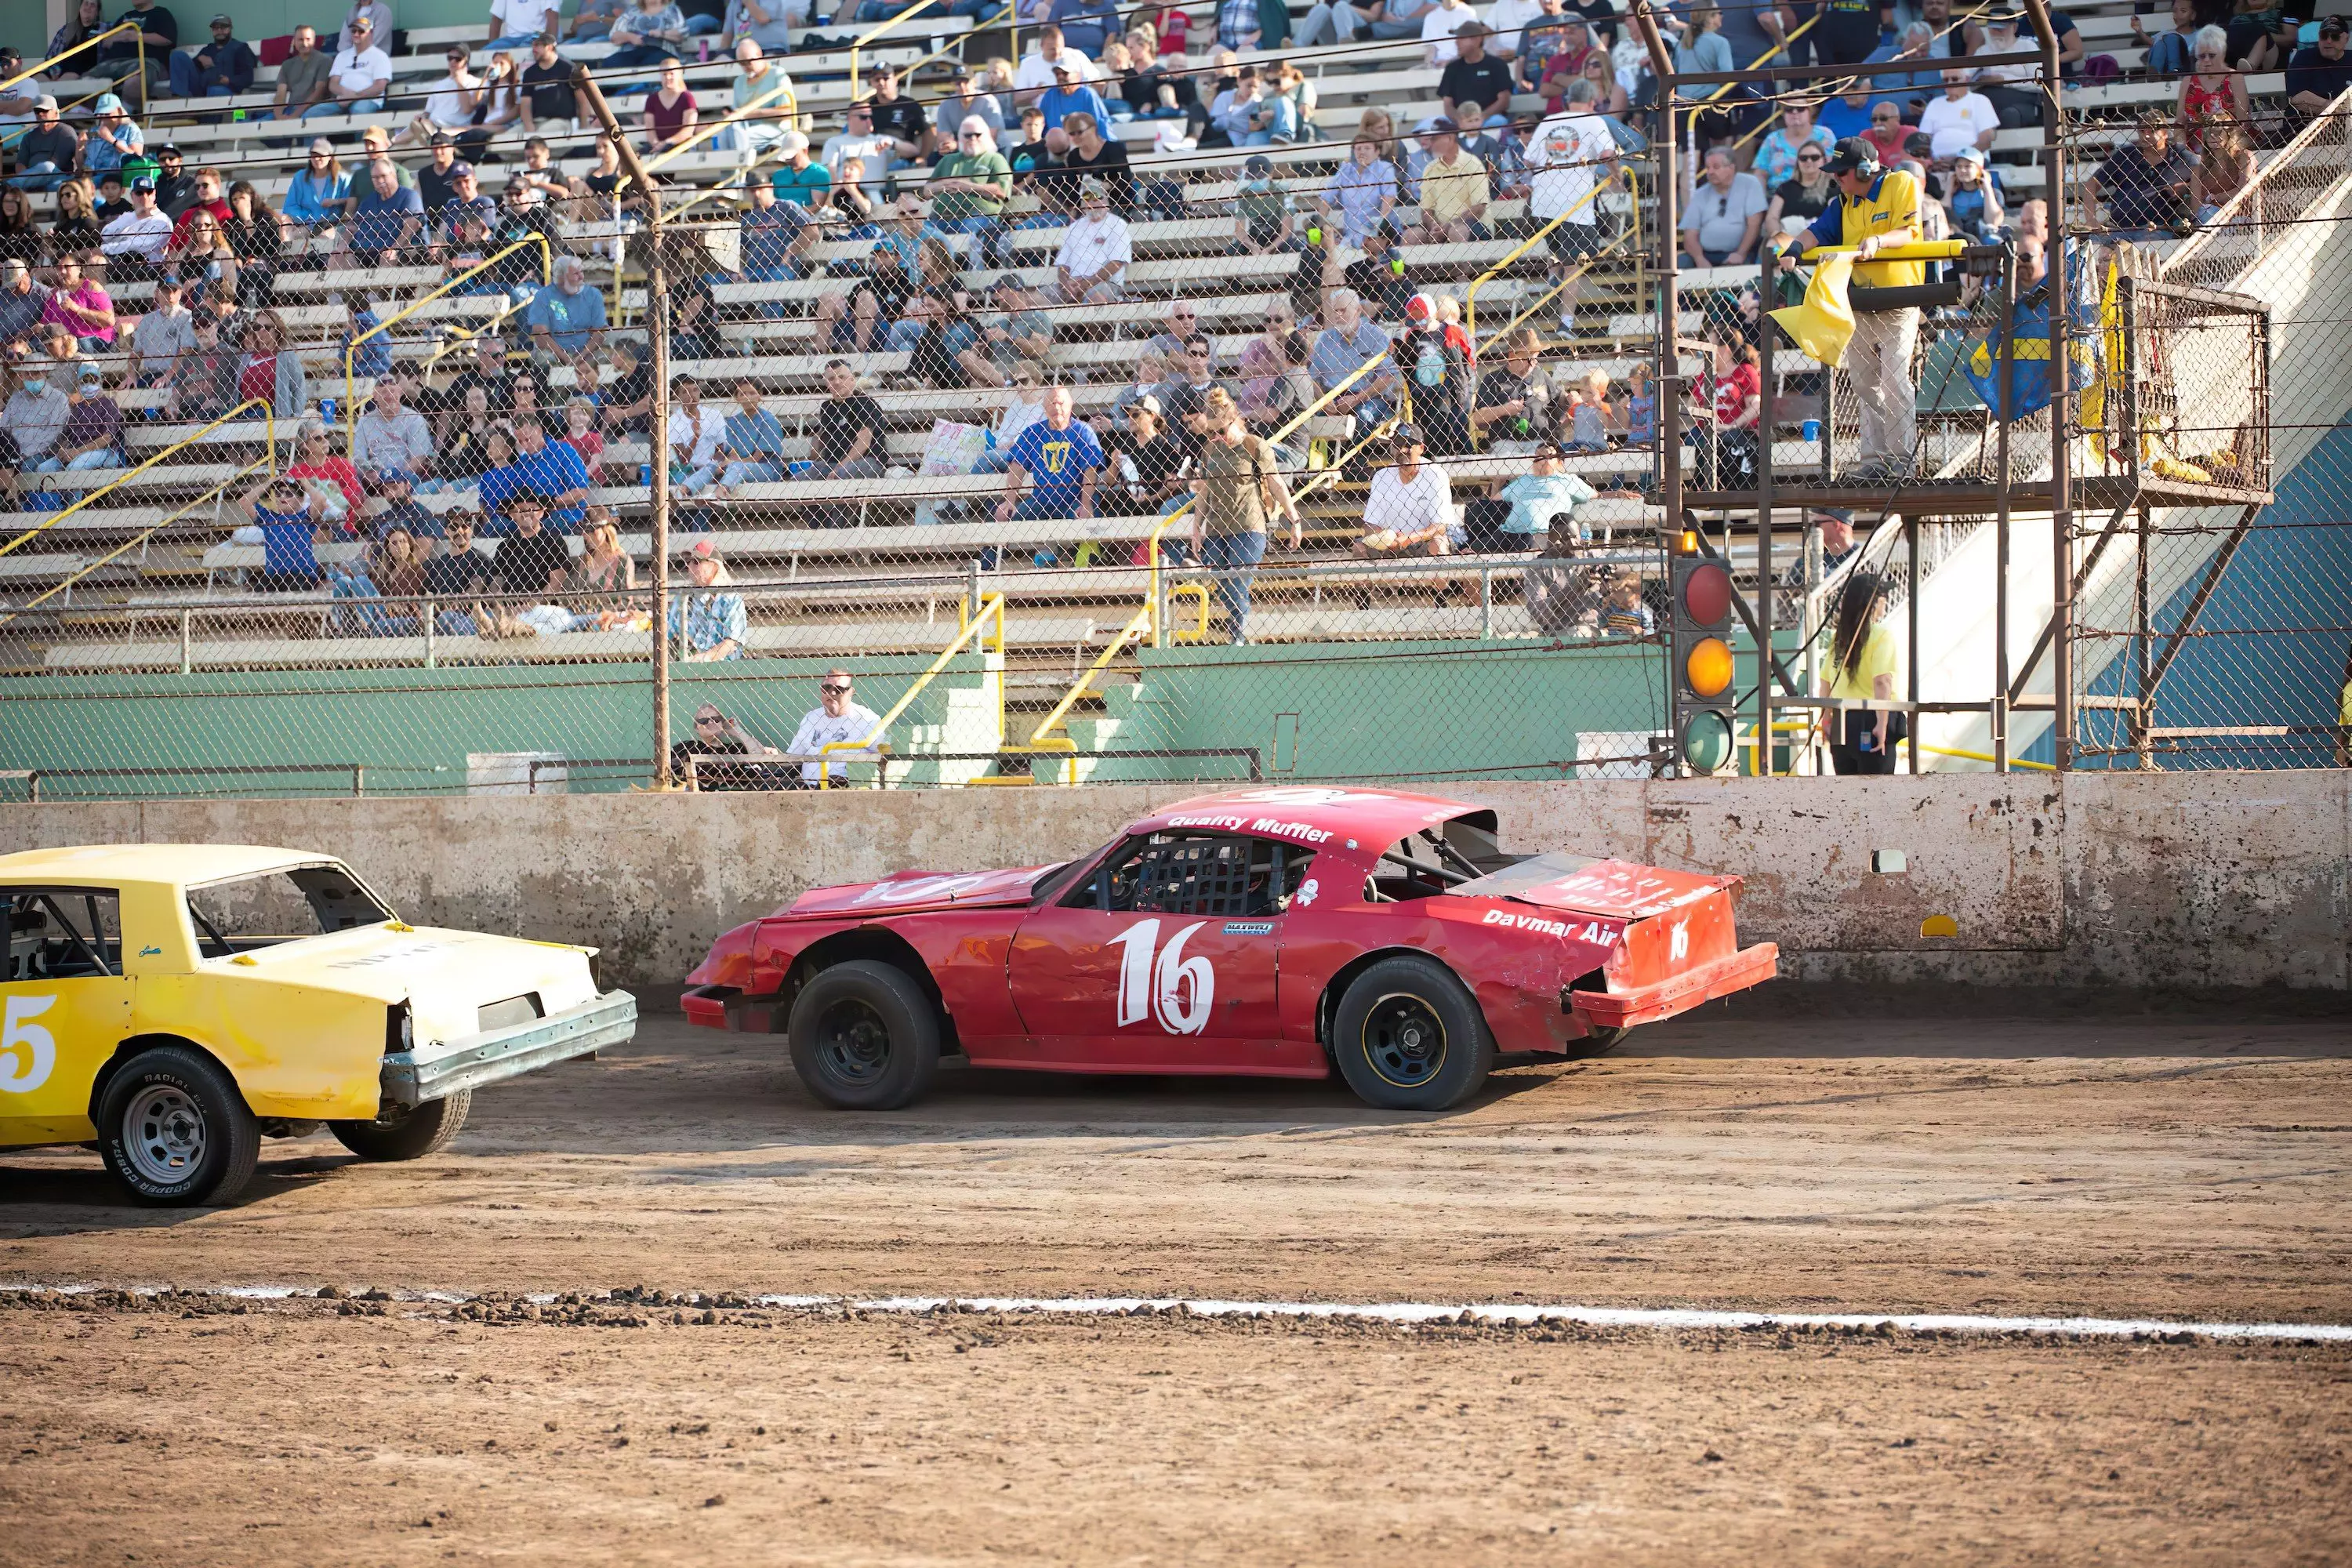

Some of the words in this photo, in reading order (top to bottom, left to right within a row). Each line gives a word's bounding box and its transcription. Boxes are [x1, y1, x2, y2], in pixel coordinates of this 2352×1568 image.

[1167, 815, 1250, 830] Quality
[1250, 818, 1334, 844] Muffler
[1482, 909, 1578, 938] Davmar
[1577, 921, 1619, 947] Air
[1670, 914, 1690, 963] 16
[1105, 917, 1215, 1036] 16
[111, 1138, 140, 1183] COBRA
[138, 1181, 191, 1194] COOPER
